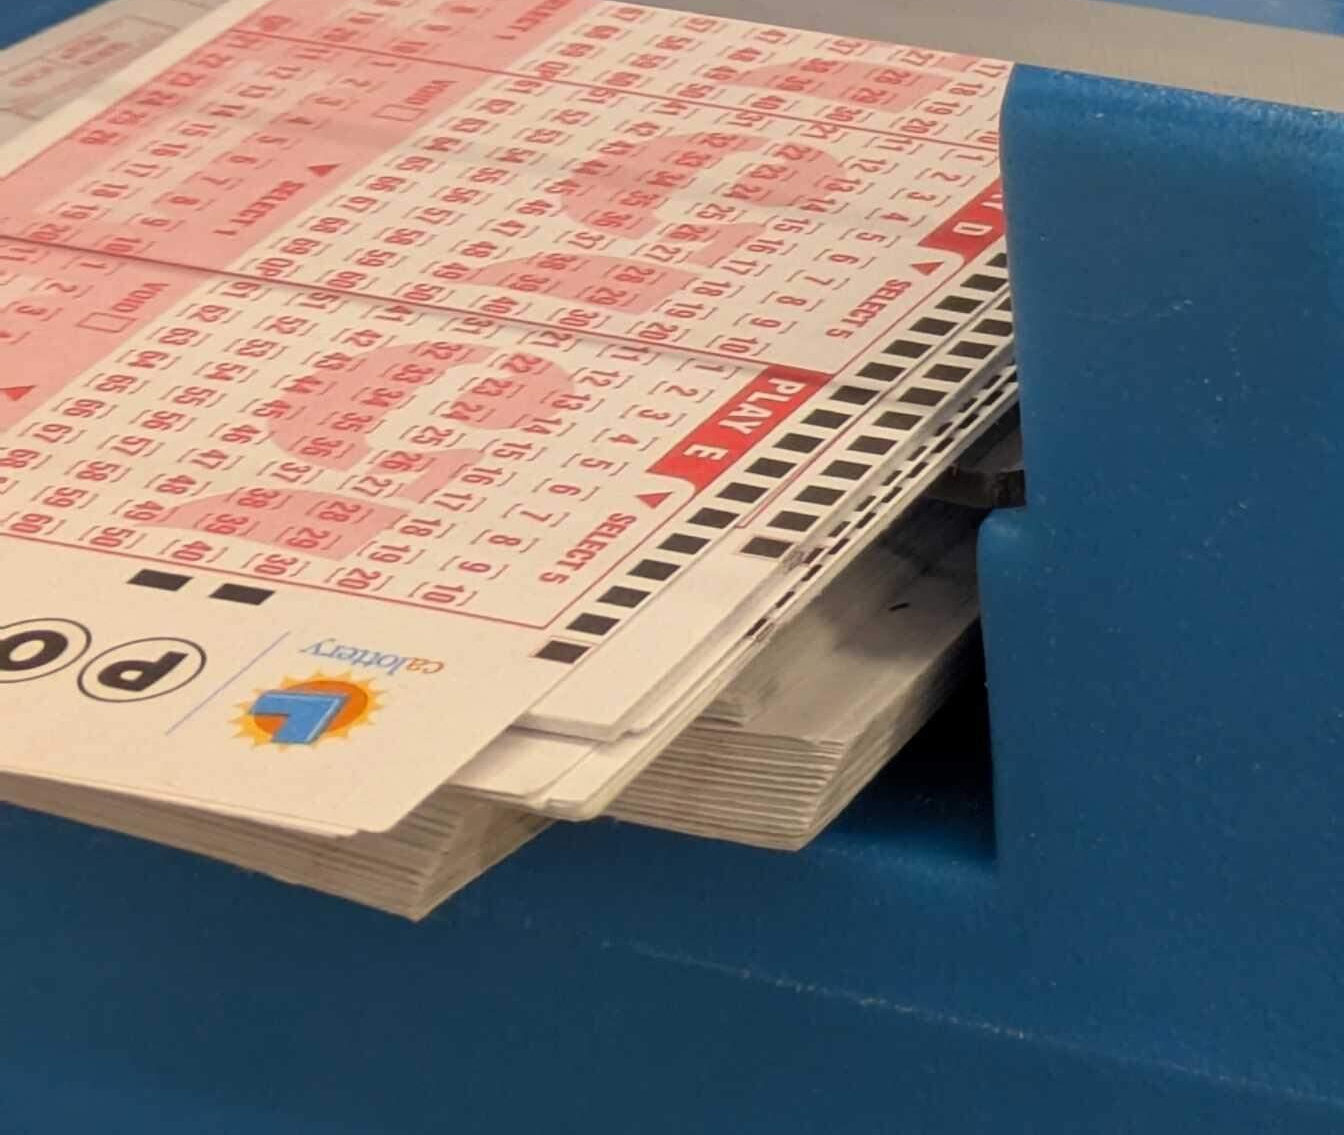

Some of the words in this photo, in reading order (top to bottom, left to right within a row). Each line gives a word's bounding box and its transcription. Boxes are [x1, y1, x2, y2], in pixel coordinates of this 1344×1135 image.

[840, 280, 914, 334] SELECT
[719, 376, 802, 434] PLAY
[681, 442, 722, 462] E
[556, 511, 638, 574] SELECT
[97, 651, 189, 693] P
[300, 638, 446, 678] calottery
